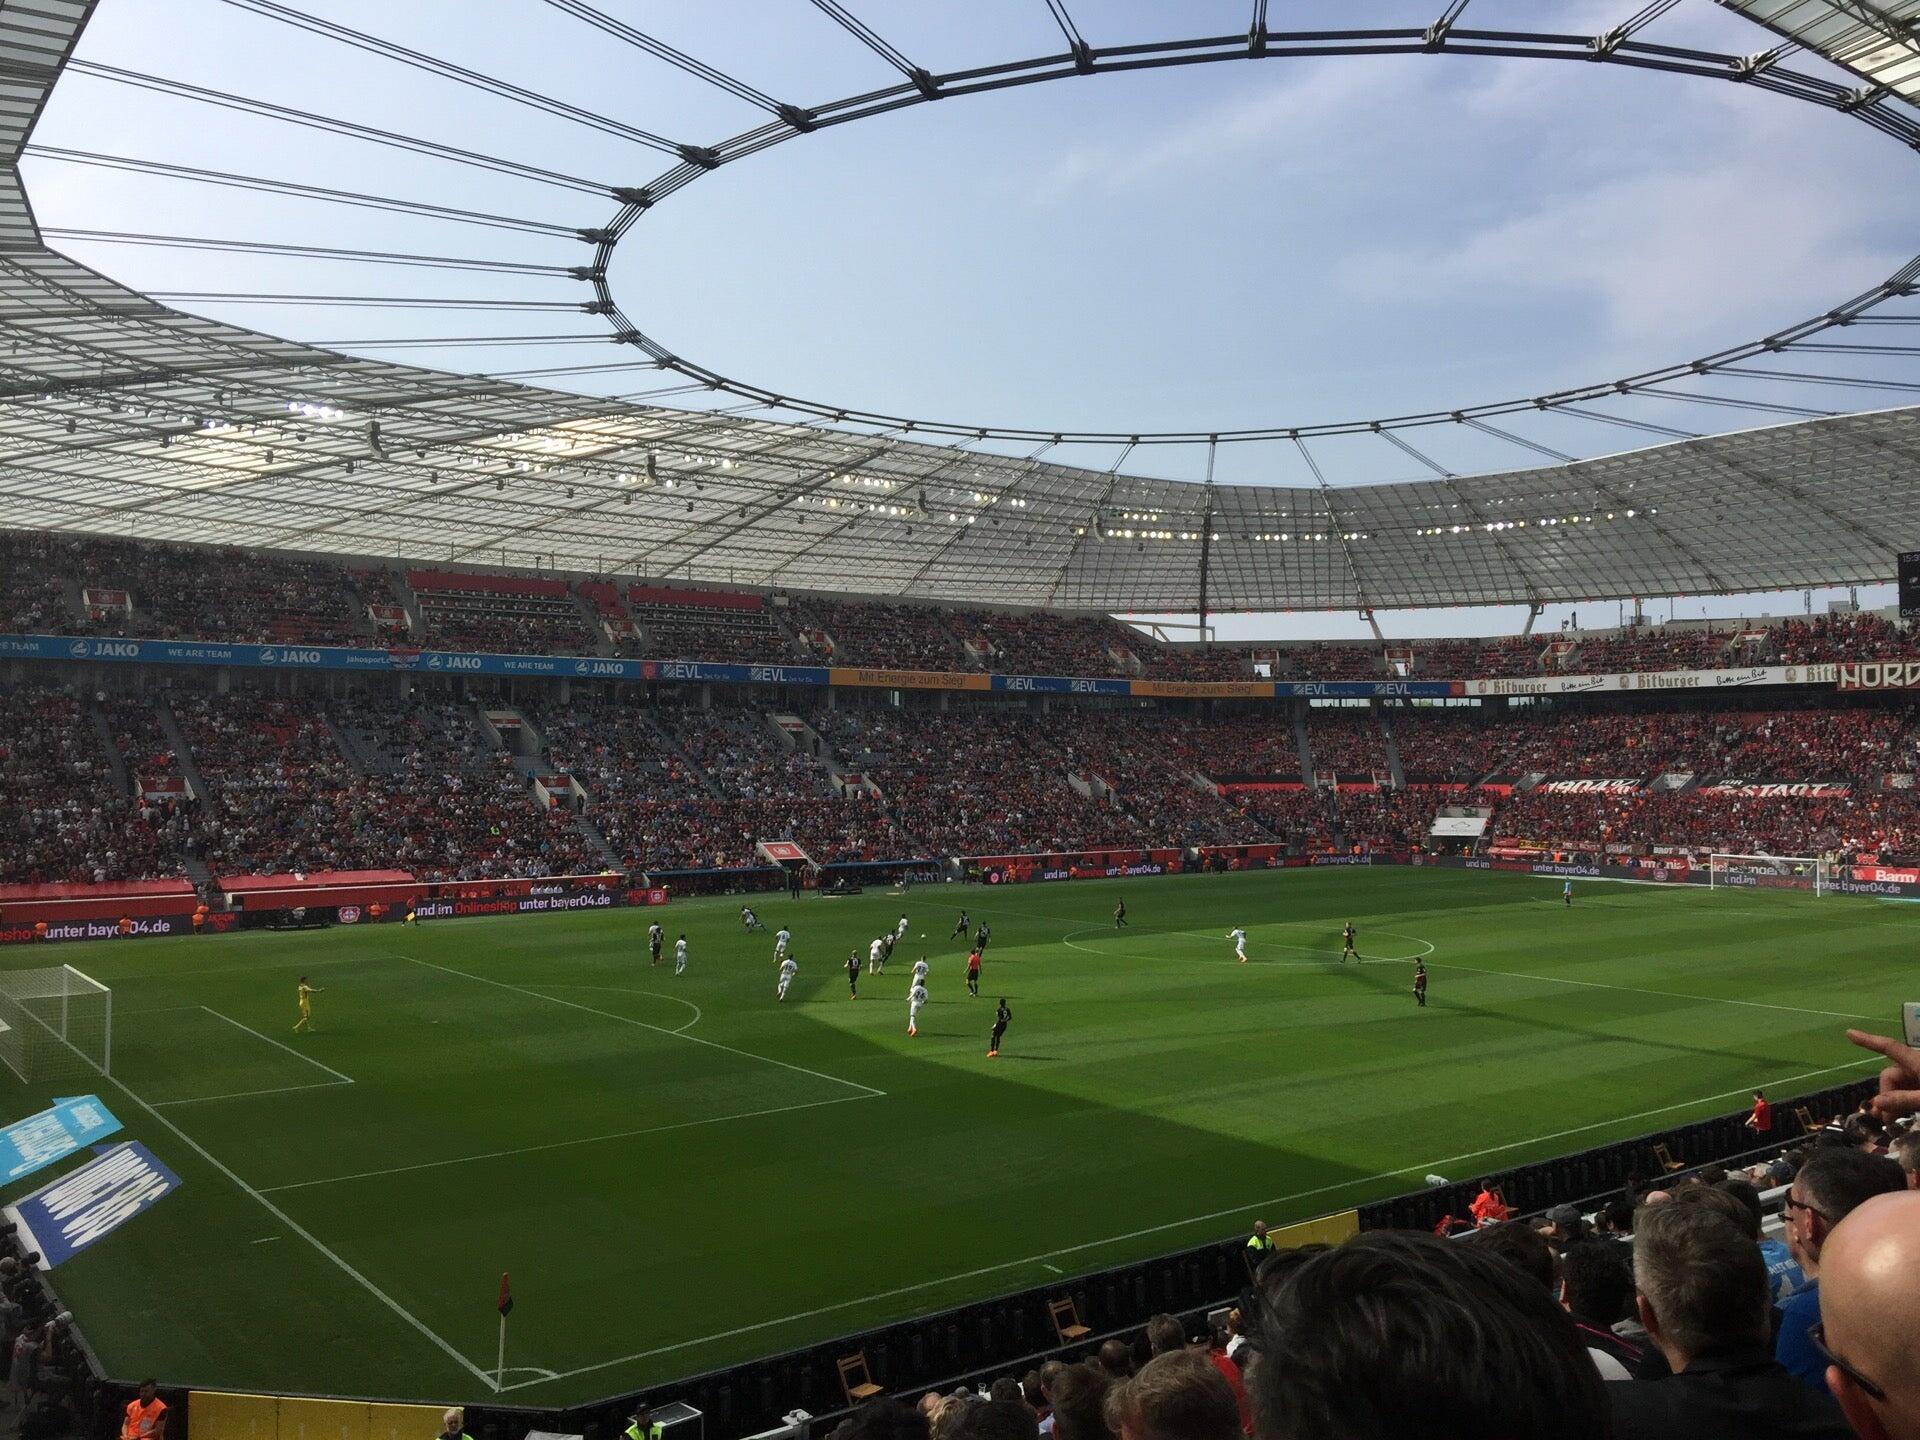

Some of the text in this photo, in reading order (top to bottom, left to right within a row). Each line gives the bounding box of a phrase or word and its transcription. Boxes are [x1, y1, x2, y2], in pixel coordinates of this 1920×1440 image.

[1903, 554, 1920, 562] 15:3
[11, 642, 40, 651] TEAM
[94, 643, 139, 657] JAKO
[168, 649, 232, 659] WE ARE TEAM
[280, 651, 321, 664] JAKO
[346, 655, 392, 665] jakosport.c
[446, 656, 482, 669] JAKO
[503, 661, 555, 671] WE ARE TEAM
[592, 662, 624, 675] JAKO
[675, 664, 703, 679] EVL
[762, 667, 787, 682] EVL
[1840, 662, 1920, 688] NORD
[858, 671, 966, 688] Mit Energie zum Sieg!
[1015, 678, 1036, 690] EVL
[1637, 673, 1700, 689] Bitburger
[1079, 680, 1099, 693] EVL
[1304, 683, 1329, 695] EVL
[1385, 683, 1411, 695] EVL
[1493, 680, 1548, 694] Bitburger
[1466, 860, 1479, 869] und
[1480, 861, 1490, 869] im
[1533, 864, 1554, 873] unter
[1554, 863, 1600, 876] bayer04.de
[1044, 870, 1058, 880] und
[1058, 869, 1068, 880] im
[1875, 869, 1918, 883] Barm
[435, 902, 453, 915] im
[454, 897, 517, 914] Onlineshop
[519, 897, 551, 910] unter
[551, 894, 611, 910] bayer04.de
[45, 924, 83, 939] unter
[39, 1148, 170, 1248] 918.com
